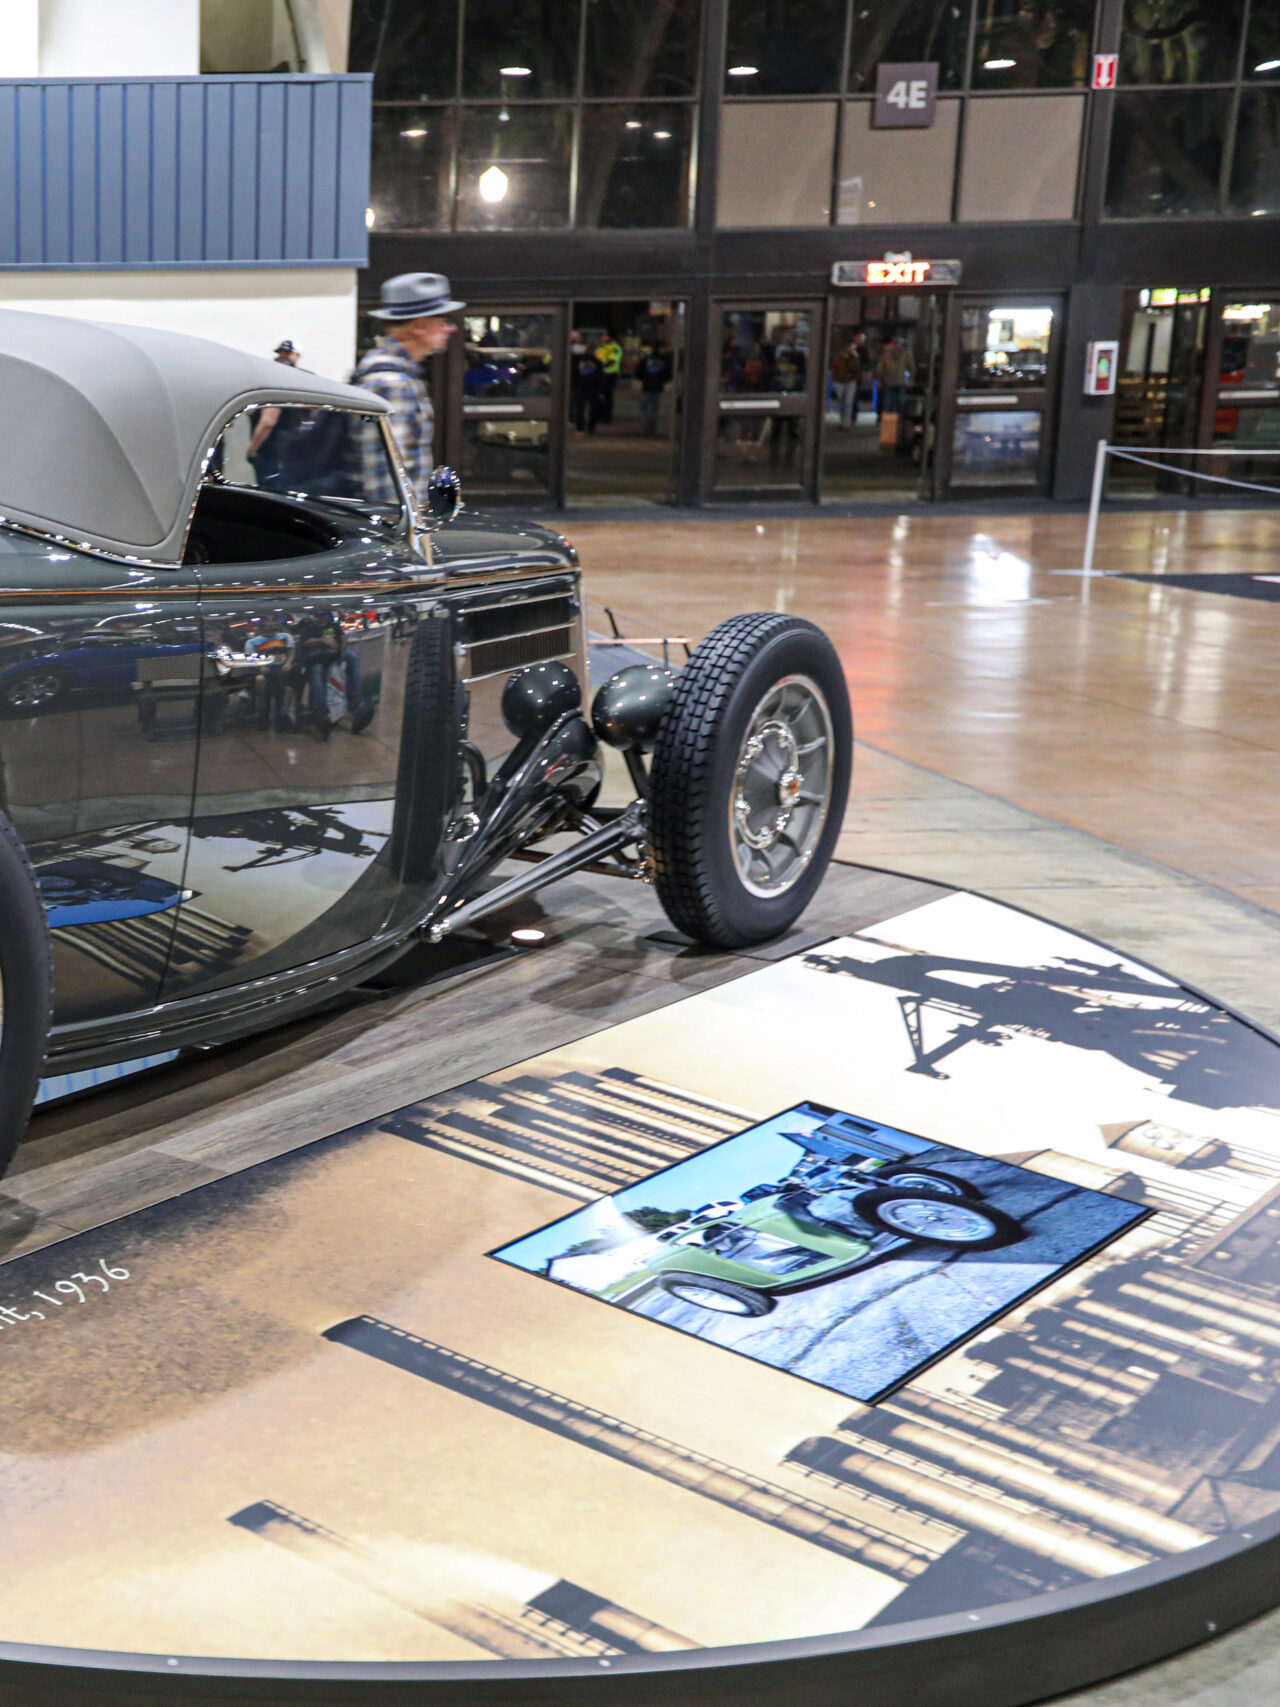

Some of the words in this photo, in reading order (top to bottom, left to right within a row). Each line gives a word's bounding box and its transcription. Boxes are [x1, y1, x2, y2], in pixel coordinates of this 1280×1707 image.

[886, 80, 928, 109] 4E
[867, 262, 930, 283] EXIT
[33, 1256, 132, 1307] 1936
